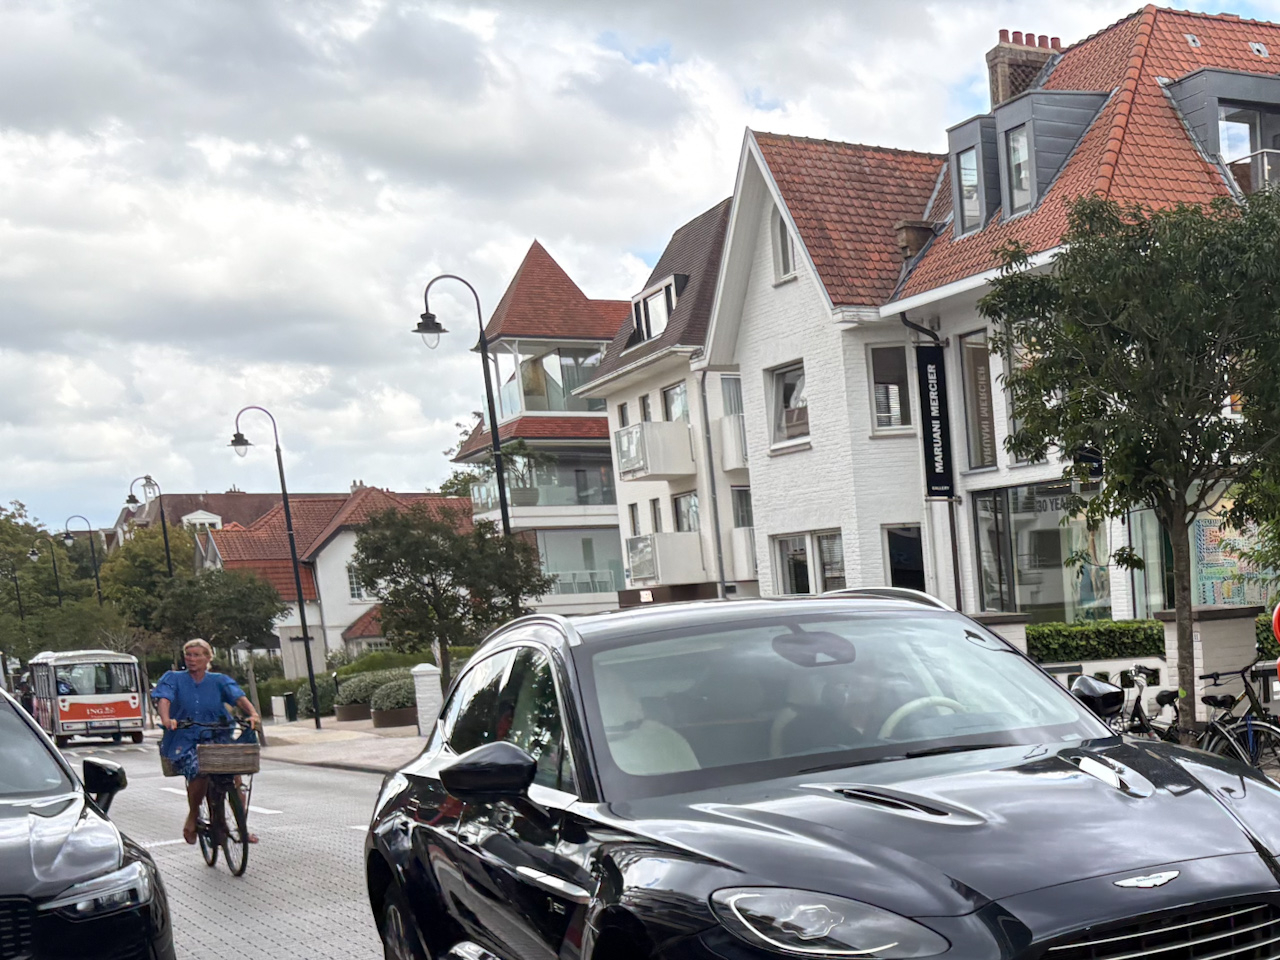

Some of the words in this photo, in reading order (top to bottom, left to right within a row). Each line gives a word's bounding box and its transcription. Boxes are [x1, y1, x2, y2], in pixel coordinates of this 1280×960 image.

[927, 364, 940, 417] MERCIER
[931, 420, 944, 473] MARUANI
[86, 707, 103, 715] ING
